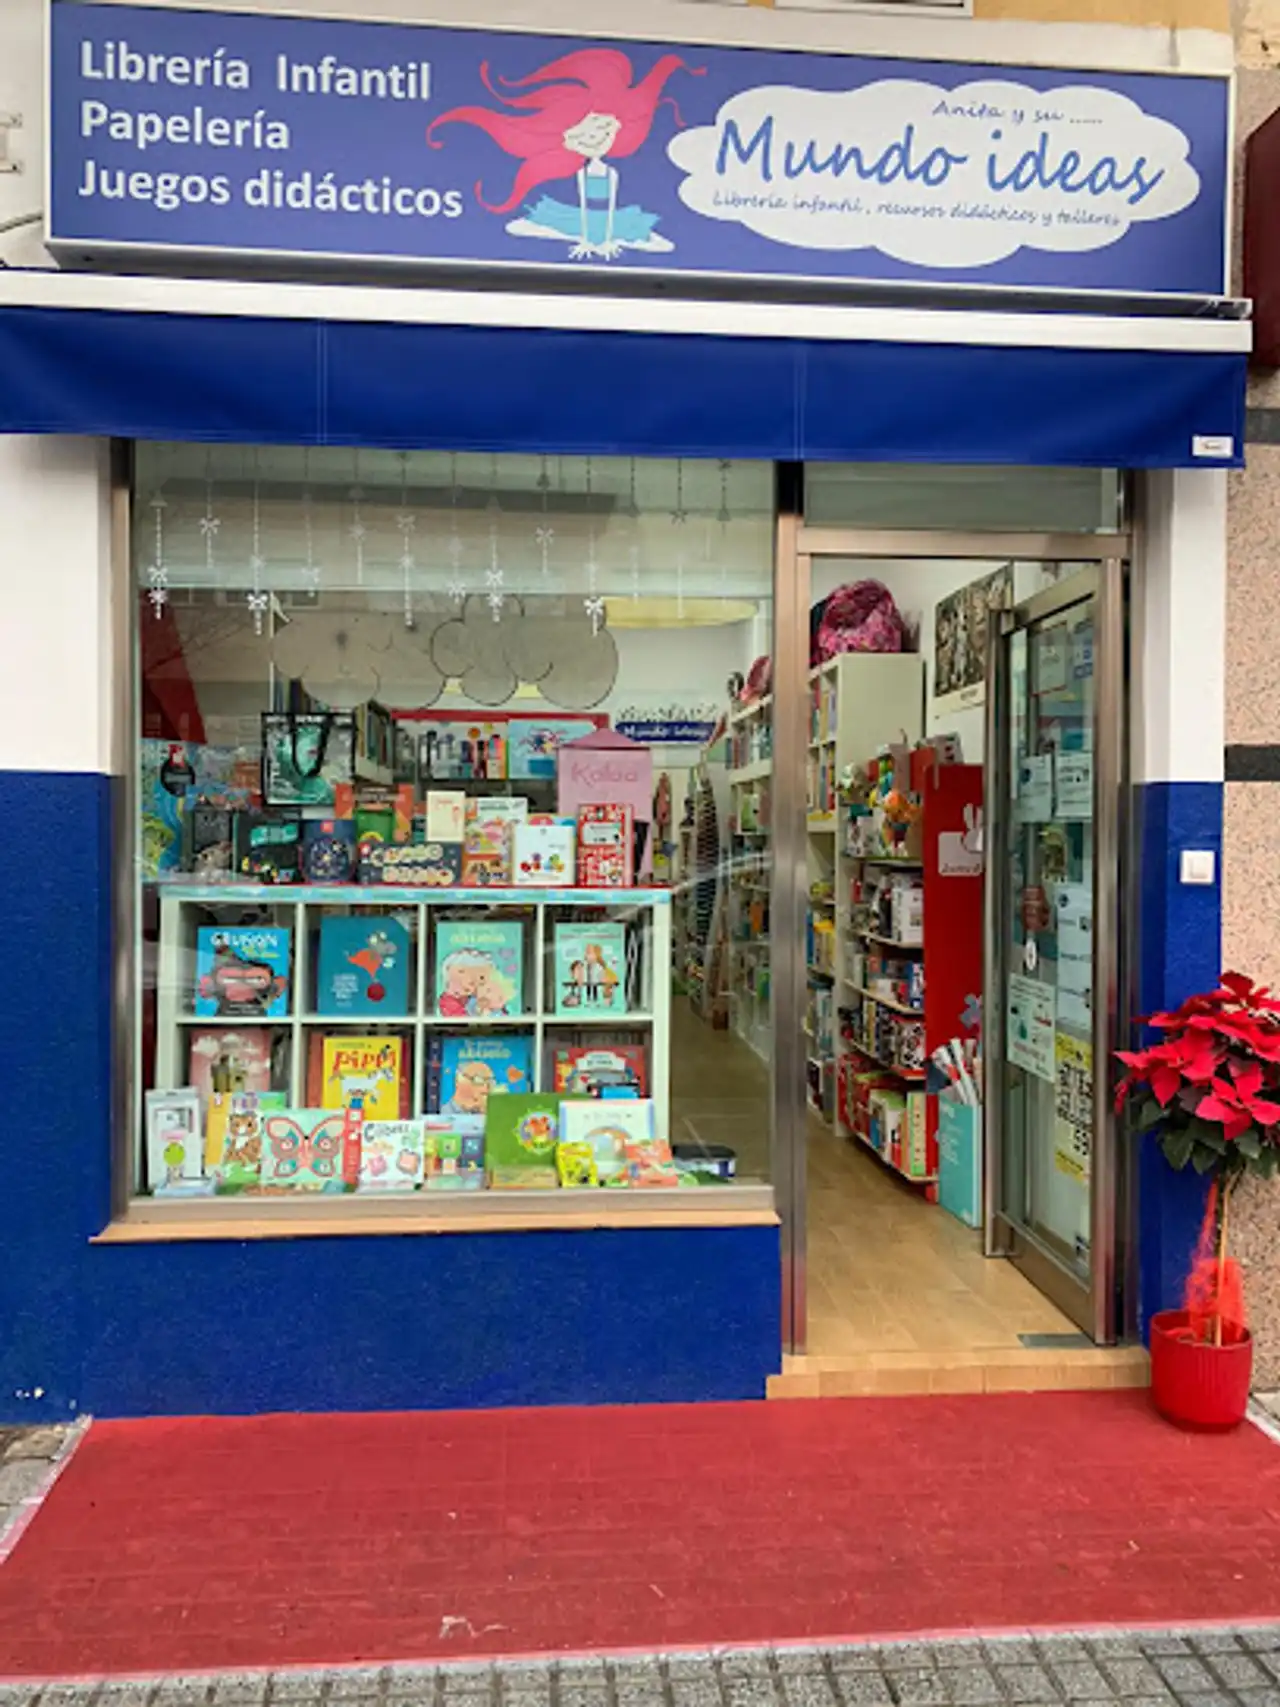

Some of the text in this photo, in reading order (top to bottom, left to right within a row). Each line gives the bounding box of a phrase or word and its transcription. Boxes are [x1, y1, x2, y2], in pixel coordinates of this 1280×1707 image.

[80, 40, 431, 100] Librería Infantil
[80, 100, 290, 149] Papelería
[932, 99, 1004, 118] Anita
[1011, 109, 1025, 126] y
[716, 115, 1165, 205] Mundo ideas
[78, 160, 463, 218] Juegos didácticos
[1041, 212, 1052, 227] y
